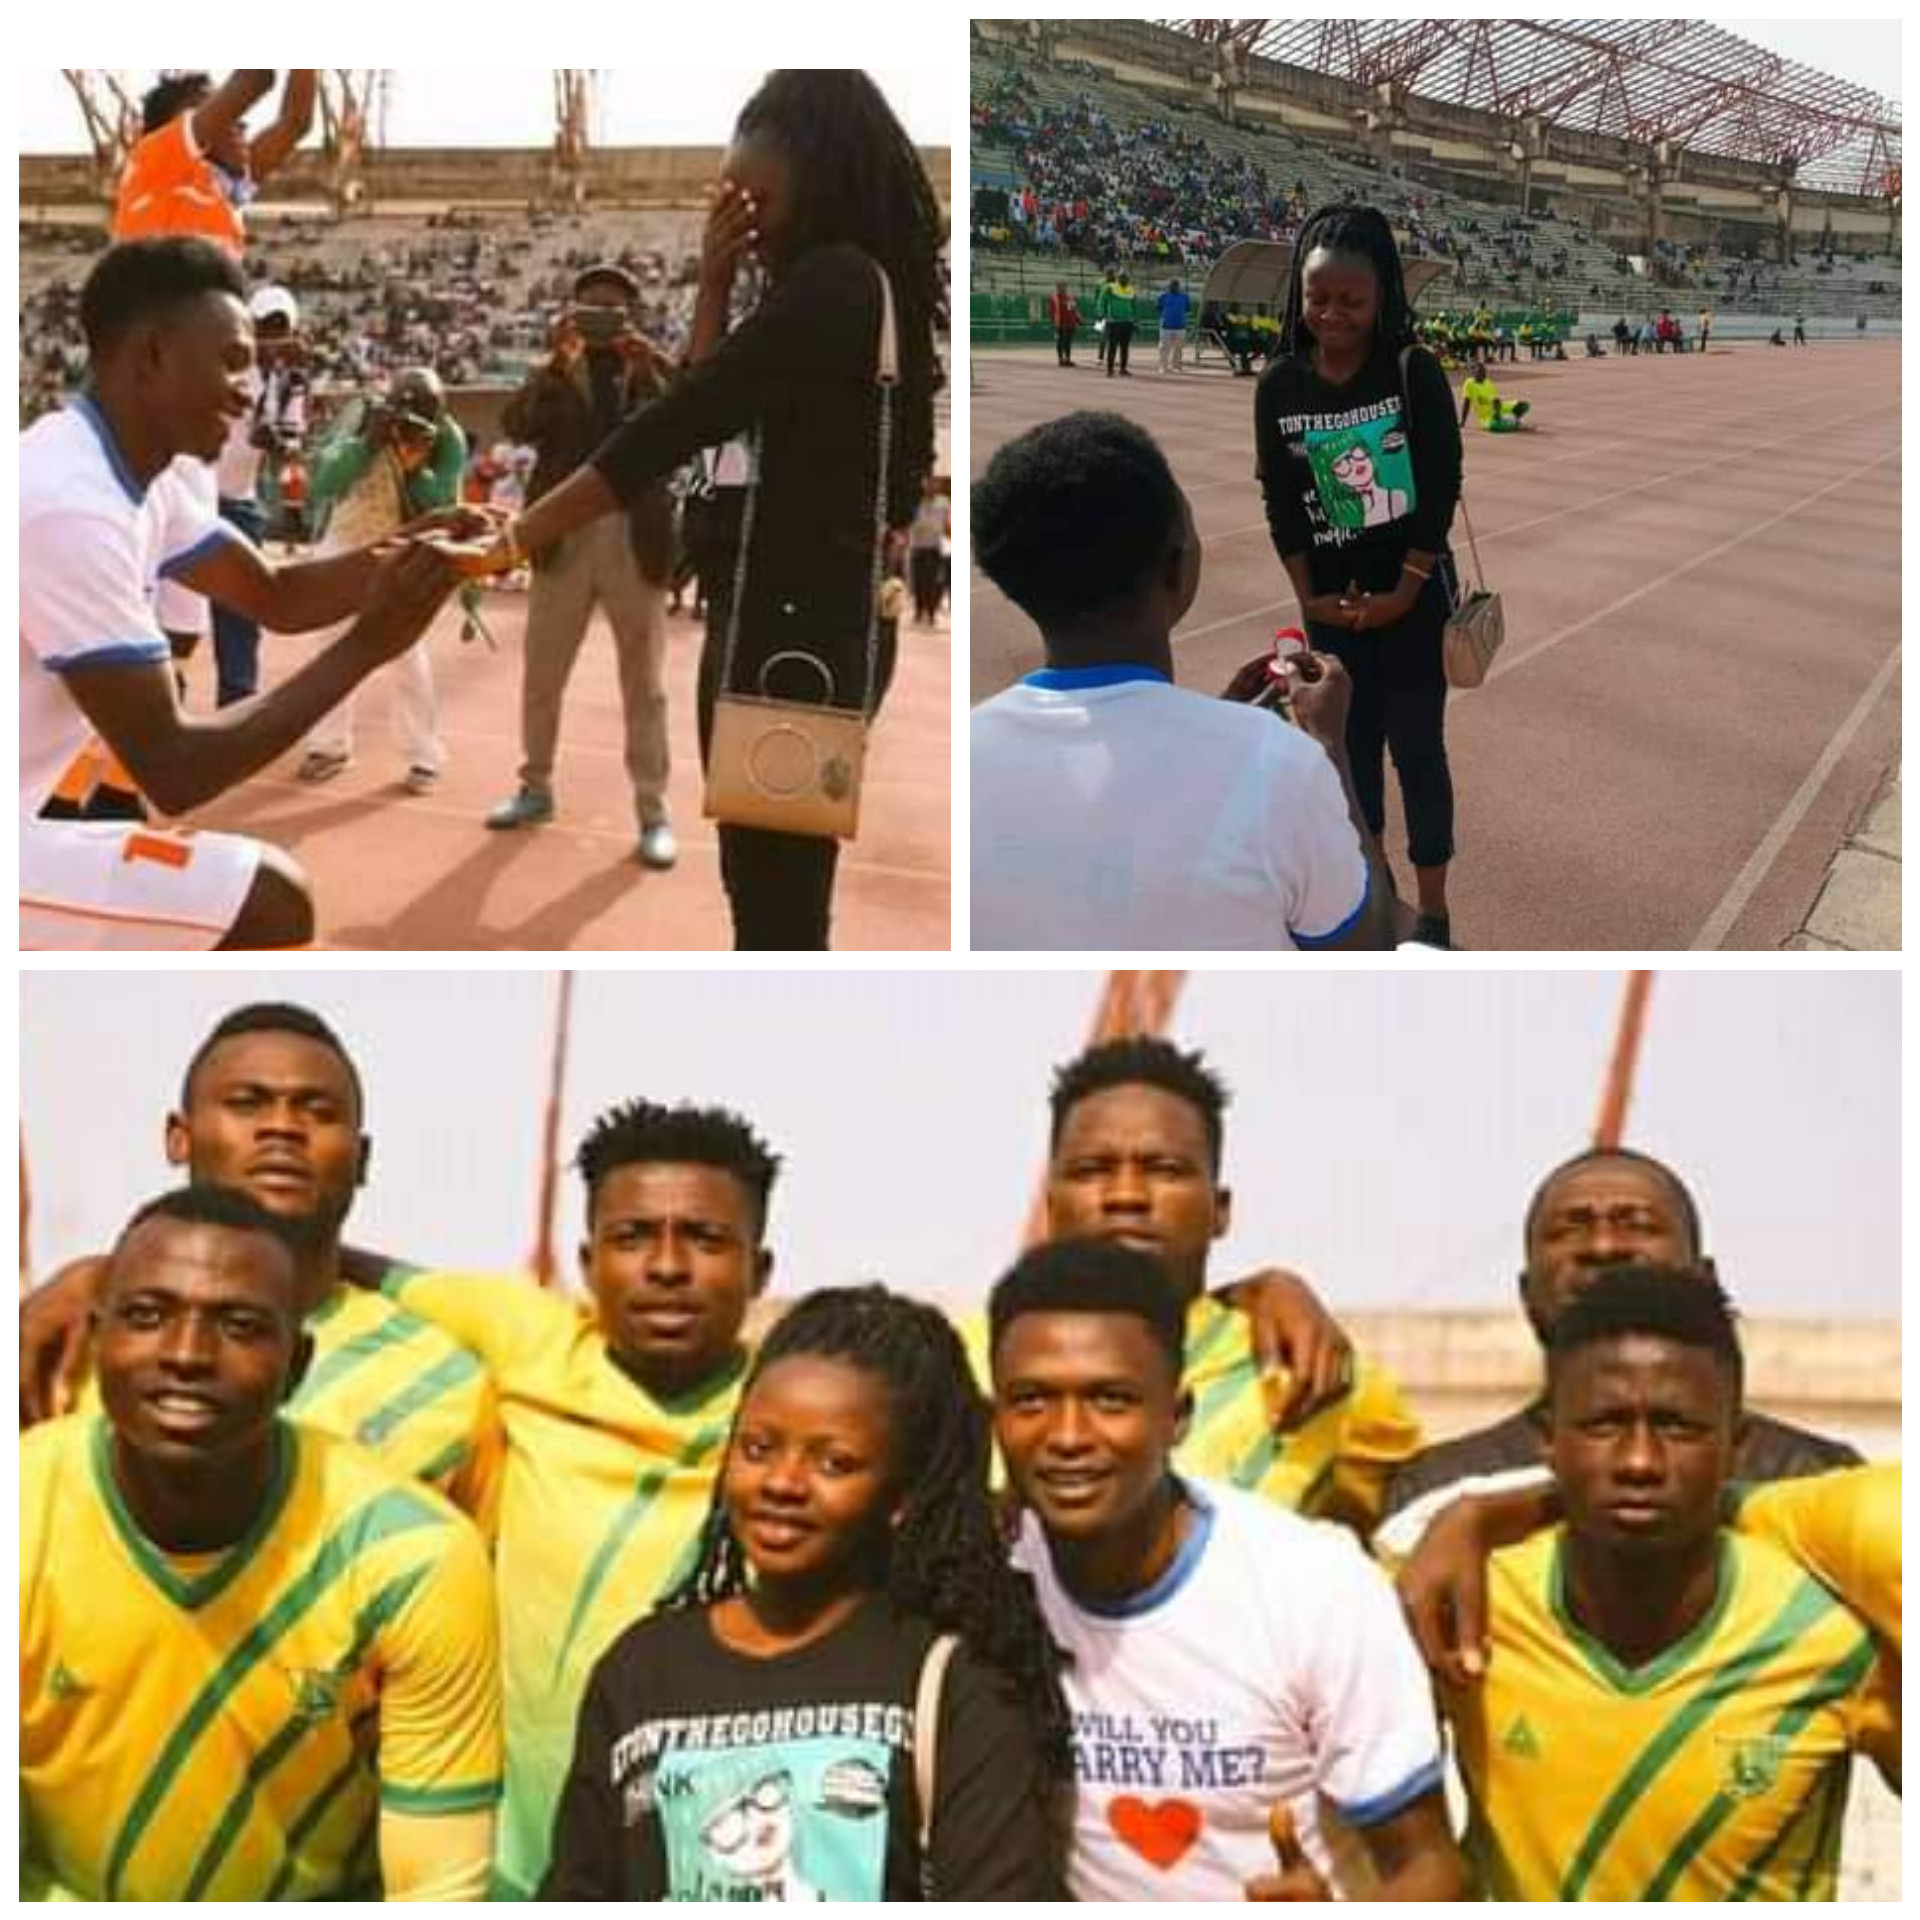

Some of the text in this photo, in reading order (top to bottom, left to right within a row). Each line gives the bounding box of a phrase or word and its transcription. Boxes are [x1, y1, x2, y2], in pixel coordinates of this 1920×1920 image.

[1149, 1715, 1219, 1746] YOU
[1073, 1743, 1266, 1789] ARRY ME?
